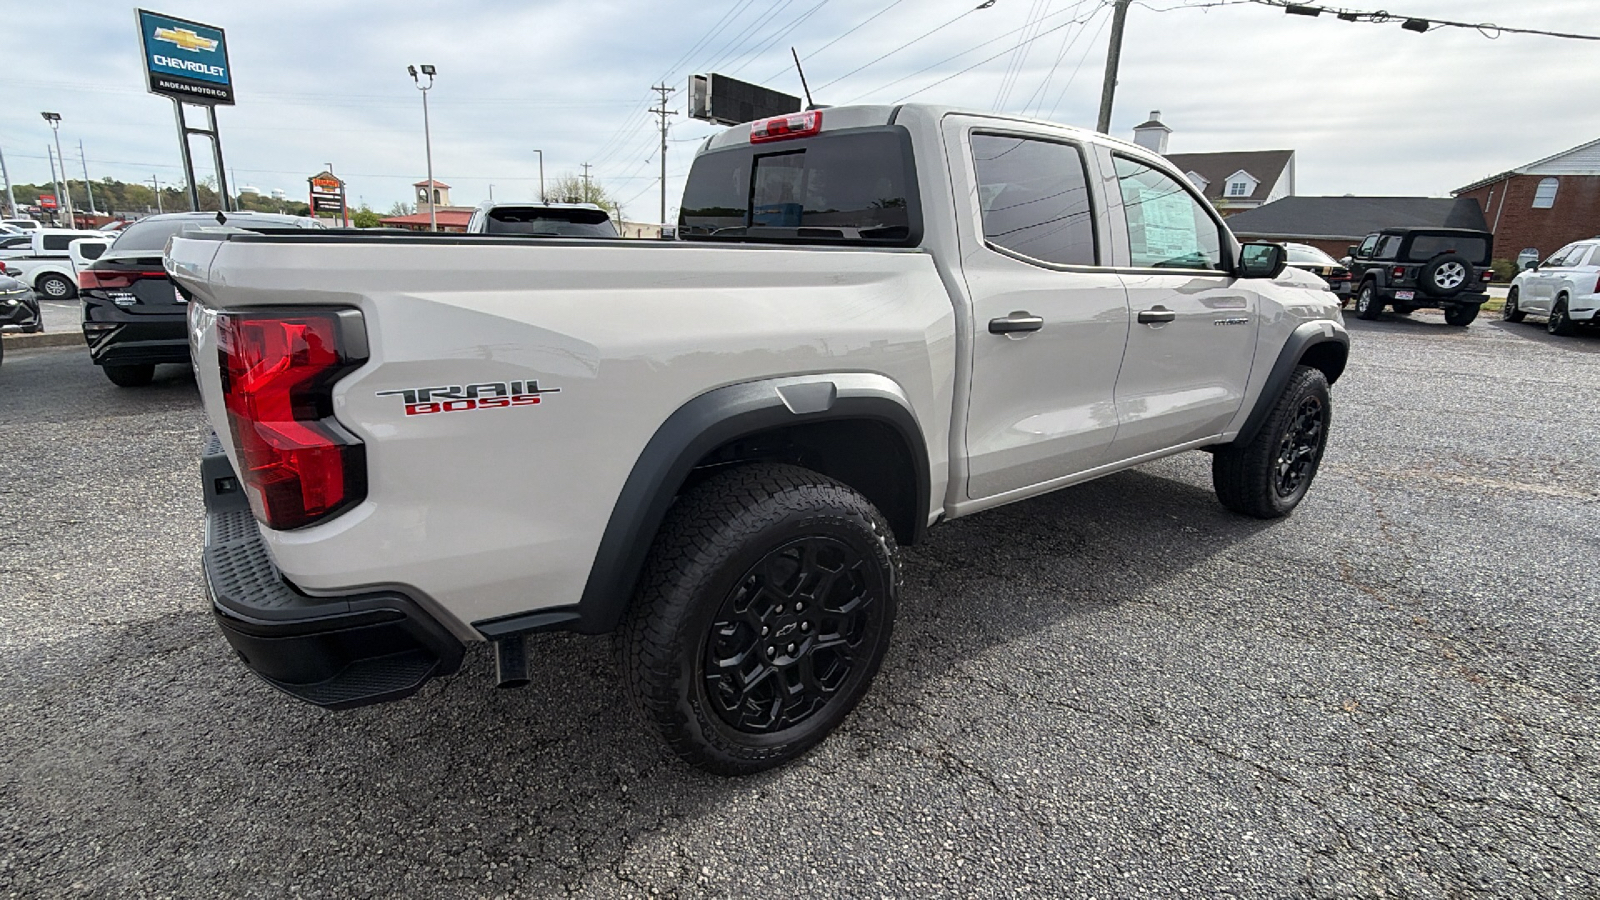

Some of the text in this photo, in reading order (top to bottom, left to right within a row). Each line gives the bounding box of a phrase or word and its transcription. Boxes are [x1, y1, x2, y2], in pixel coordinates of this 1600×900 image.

[153, 54, 224, 76] CHEVROLET
[159, 80, 191, 91] ANDEAN
[191, 86, 216, 95] MOTOR
[376, 380, 561, 404] TRAIL
[405, 395, 541, 417] BOSS
